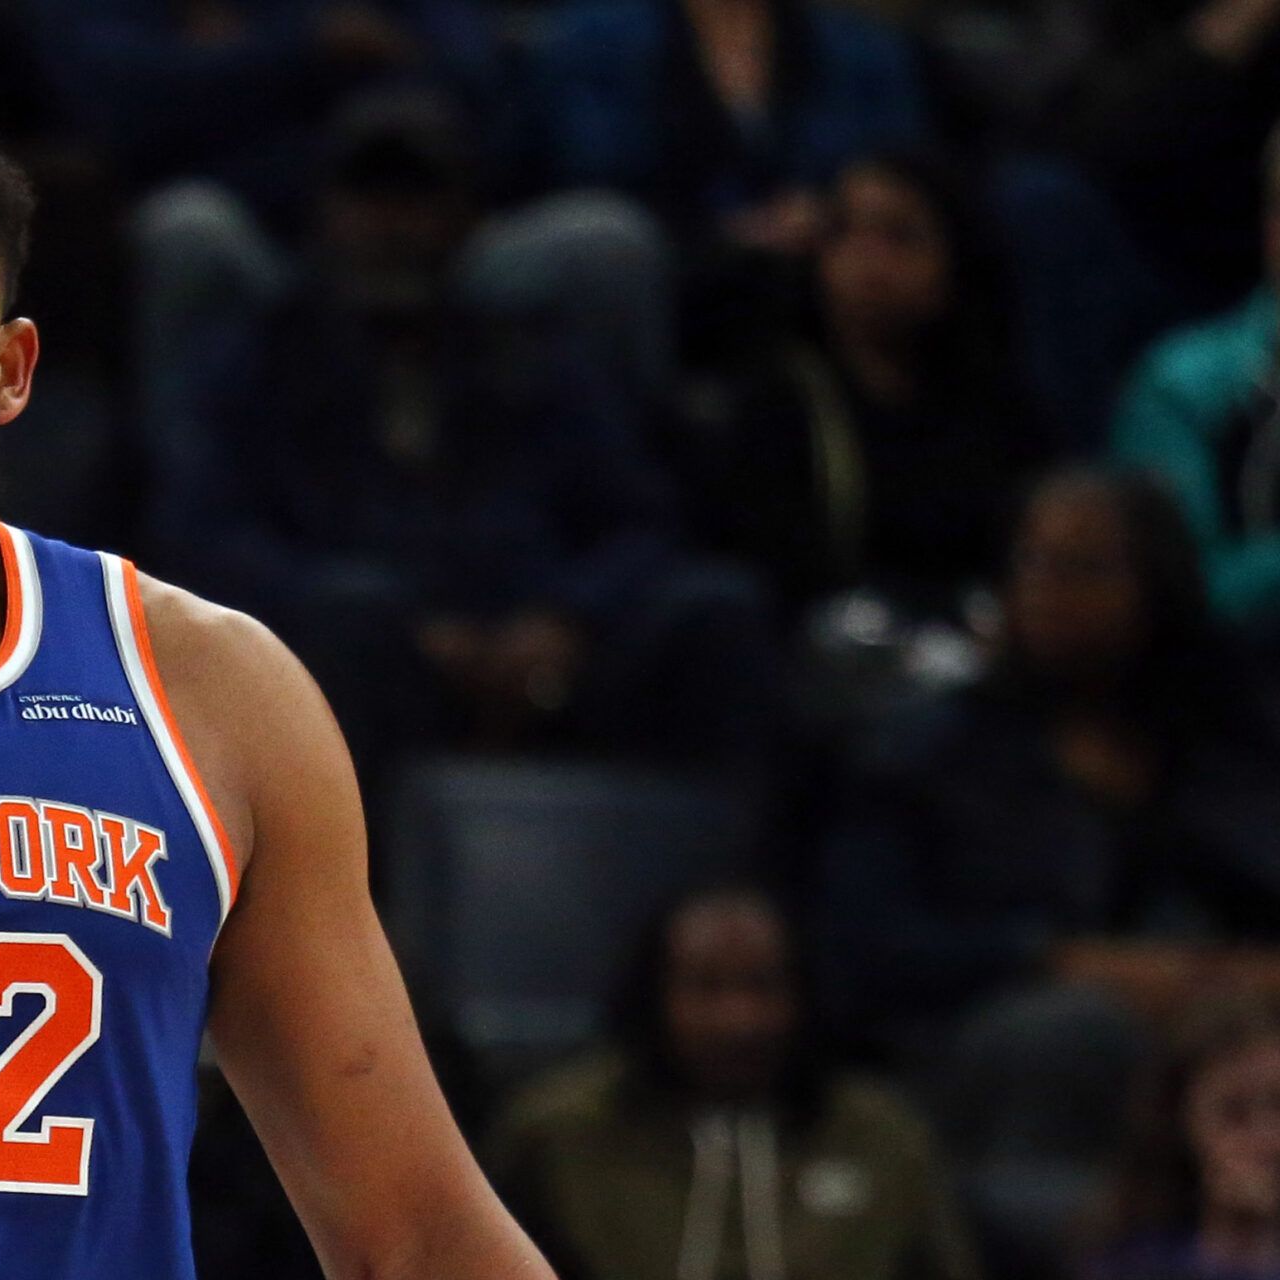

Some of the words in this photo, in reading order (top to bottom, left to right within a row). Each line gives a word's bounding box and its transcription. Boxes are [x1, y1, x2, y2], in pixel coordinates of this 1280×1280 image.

[19, 694, 82, 703] experience
[22, 703, 69, 720] abu
[71, 703, 138, 725] dhabi
